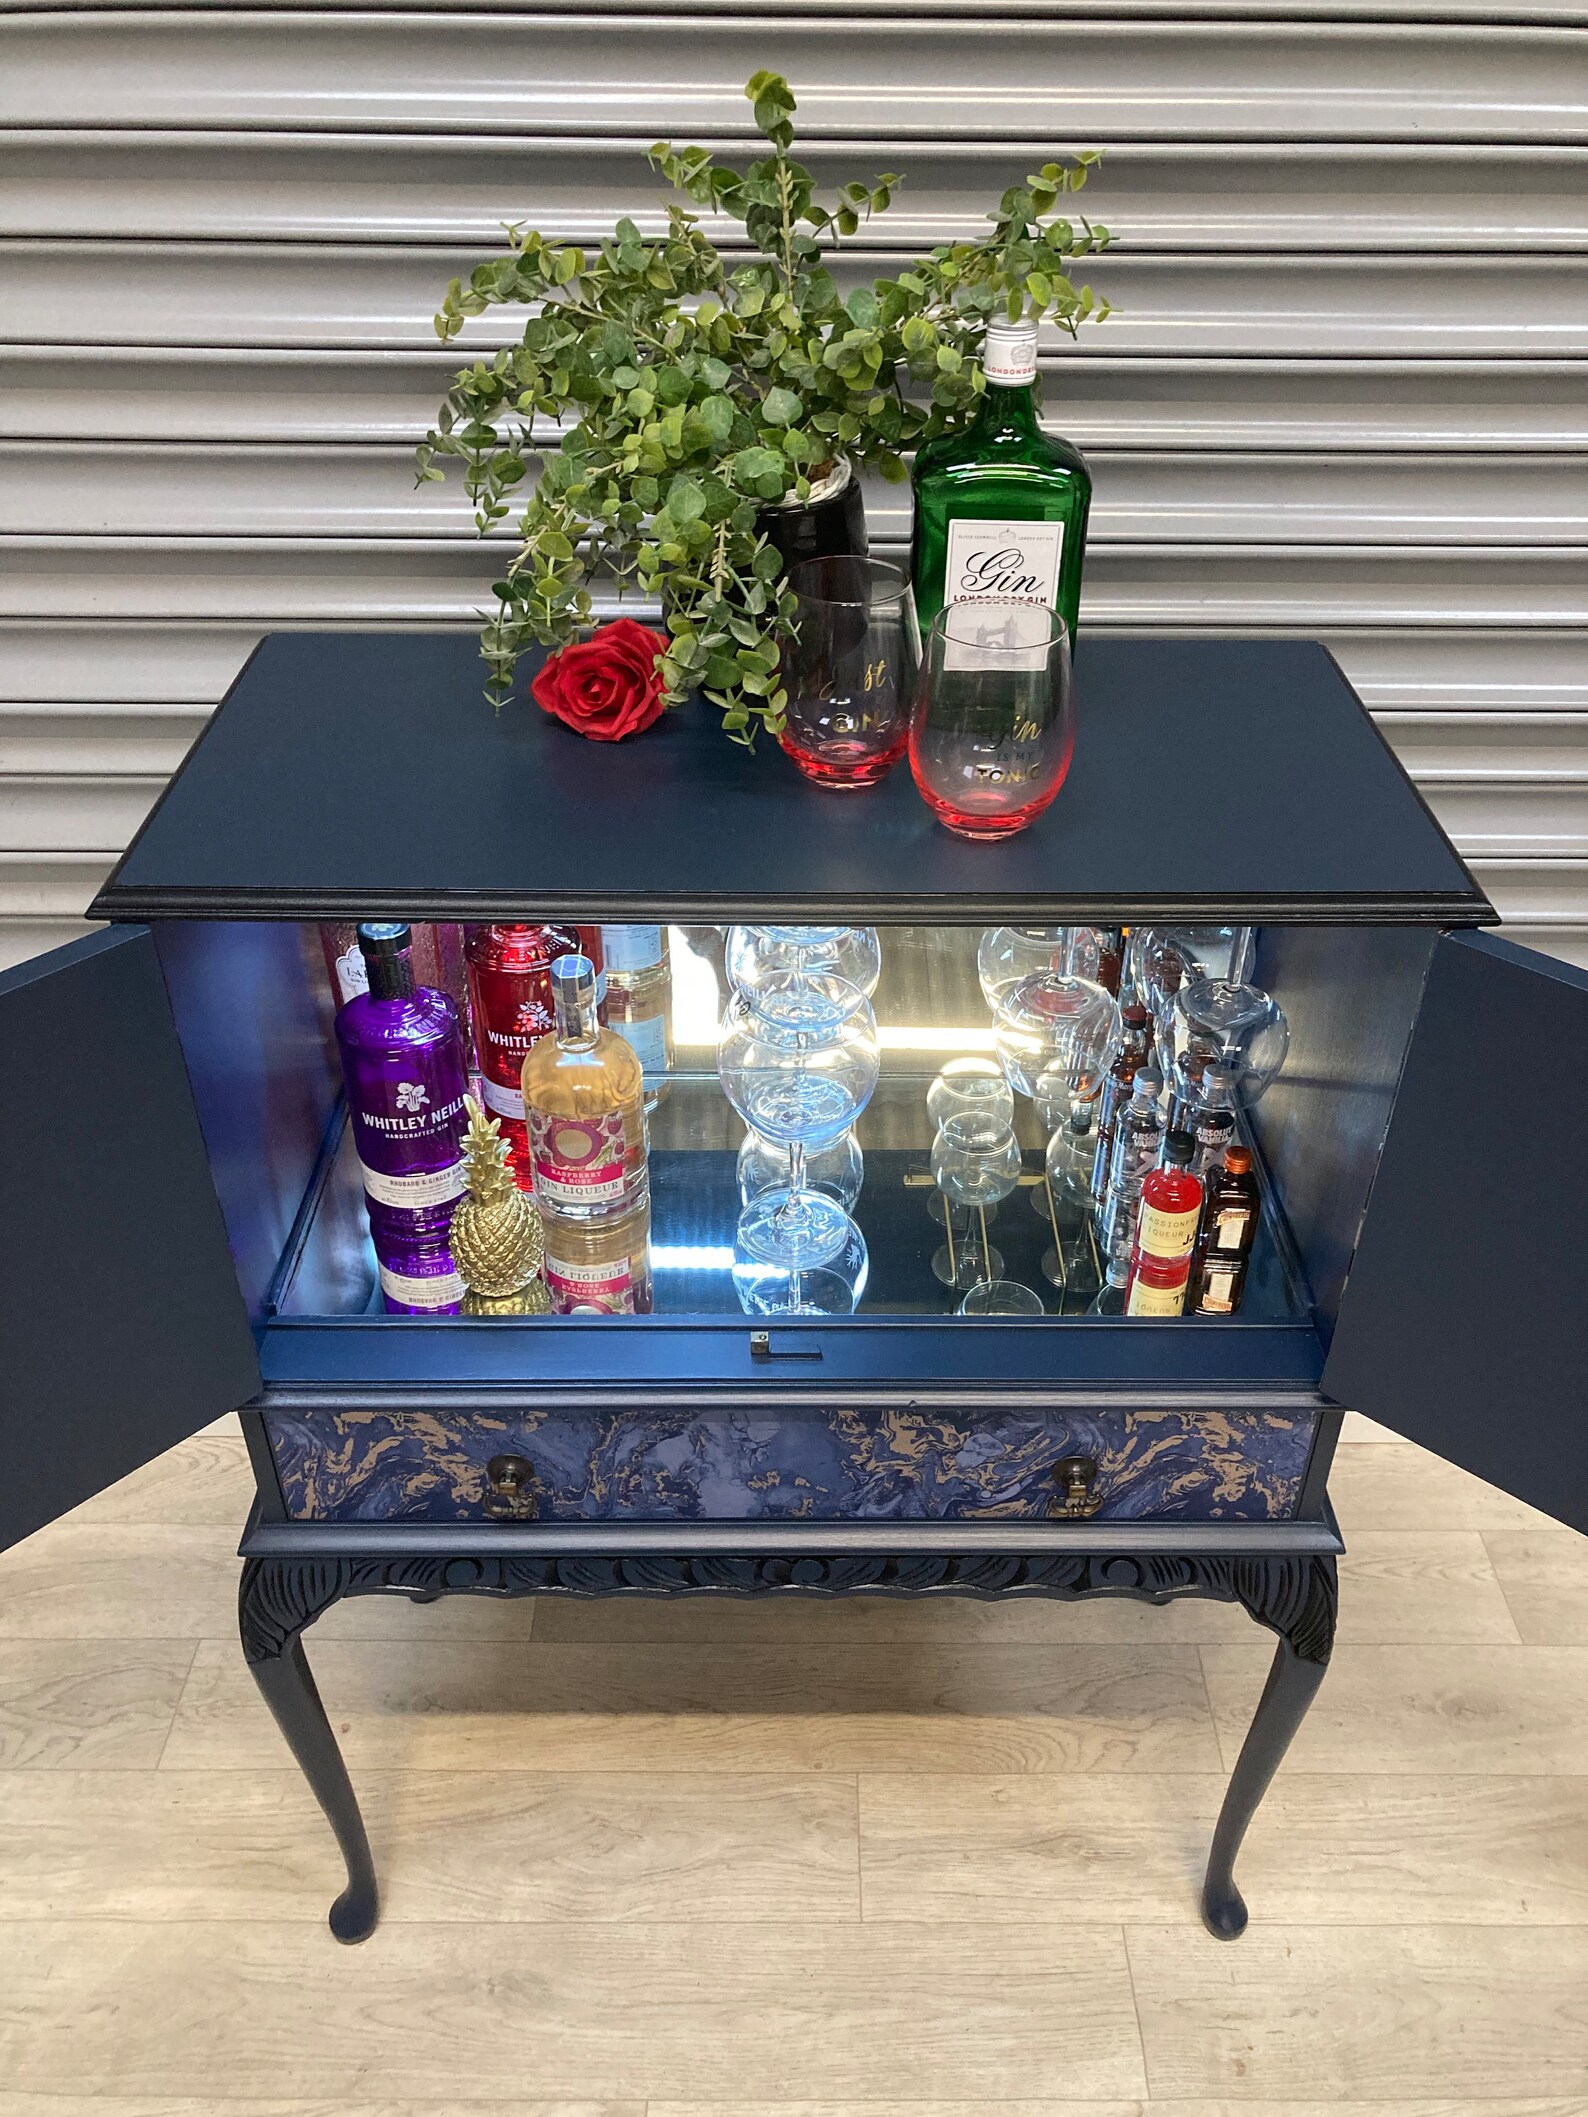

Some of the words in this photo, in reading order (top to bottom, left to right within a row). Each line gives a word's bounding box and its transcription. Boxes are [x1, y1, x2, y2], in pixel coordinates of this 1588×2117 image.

[960, 548, 1045, 593] Gin
[1016, 751, 1034, 761] MY
[977, 764, 1042, 785] TONIC
[488, 1029, 544, 1049] WHITLE
[361, 1111, 427, 1132] WHITLEY
[430, 1096, 465, 1125] NEILL
[384, 1128, 436, 1140] HANDCRAFTED
[437, 1122, 449, 1132] GIN
[389, 1179, 420, 1188] RHUBARB
[428, 1171, 452, 1185] GINGER
[551, 1168, 602, 1179] RASPBERRY
[540, 1176, 558, 1191] GIN
[562, 1181, 619, 1196] LIQUEUR
